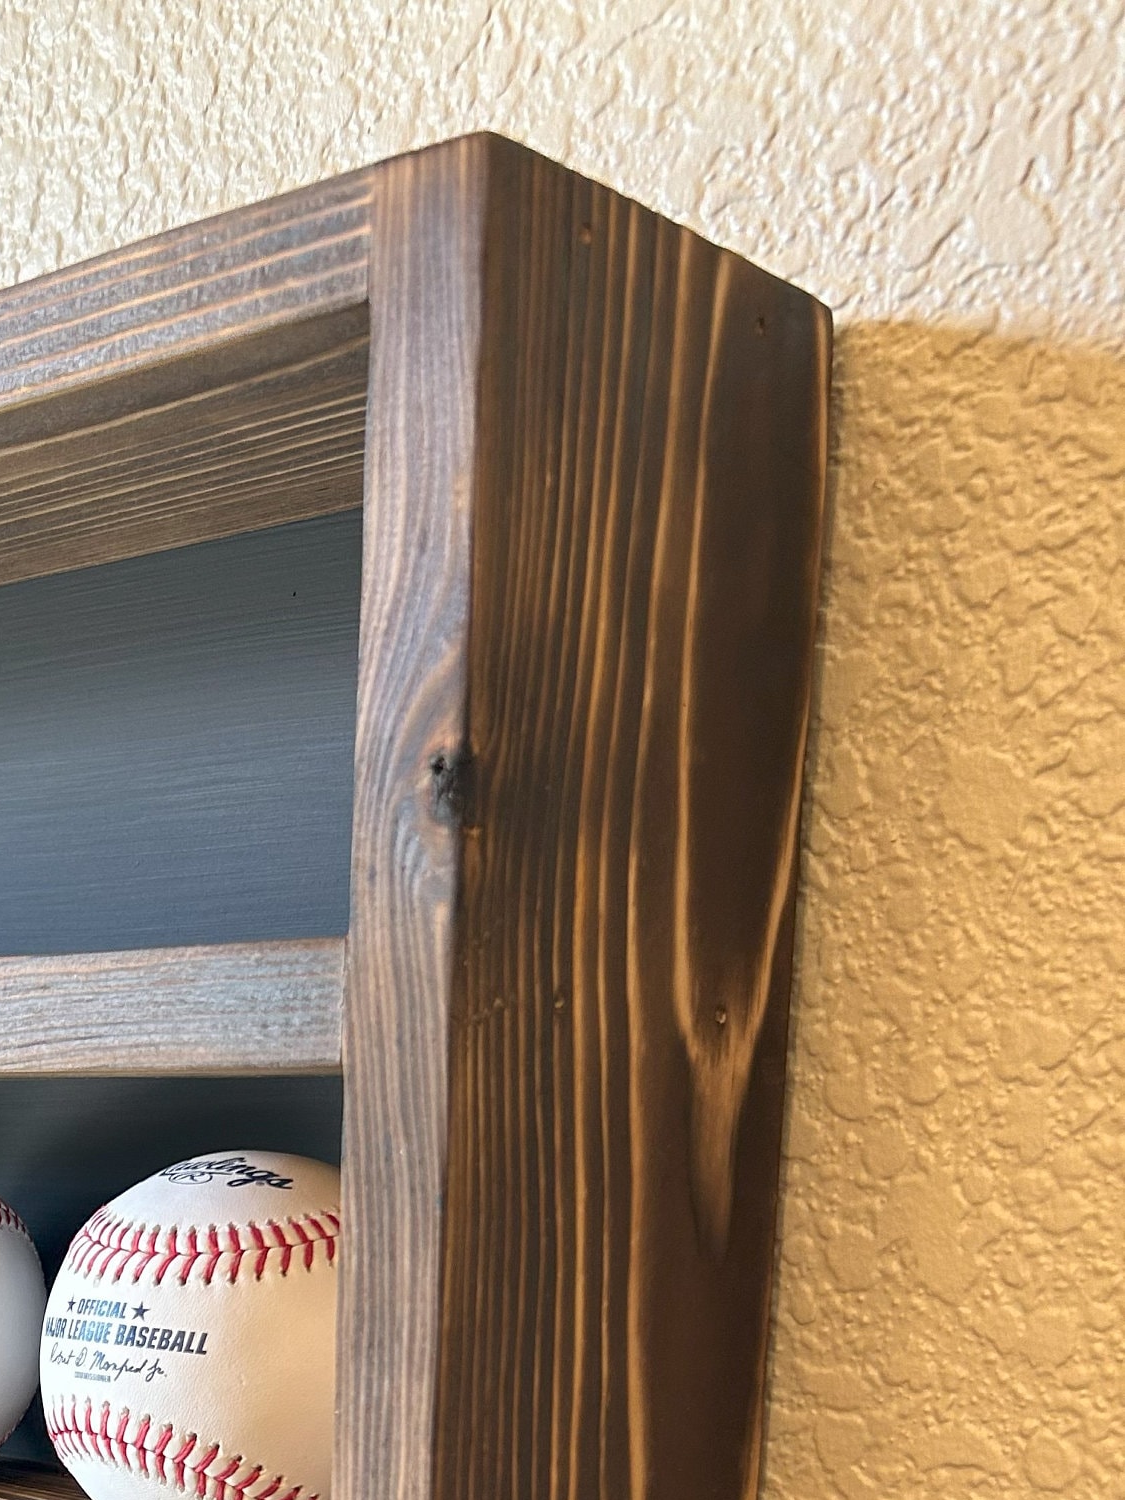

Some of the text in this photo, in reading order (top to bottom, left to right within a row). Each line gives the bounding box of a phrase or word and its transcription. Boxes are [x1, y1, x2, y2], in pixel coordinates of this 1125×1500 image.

[77, 1298, 128, 1319] OFFICIAL
[67, 1319, 113, 1344] LEAGUE
[114, 1324, 209, 1355] BASEBALL
